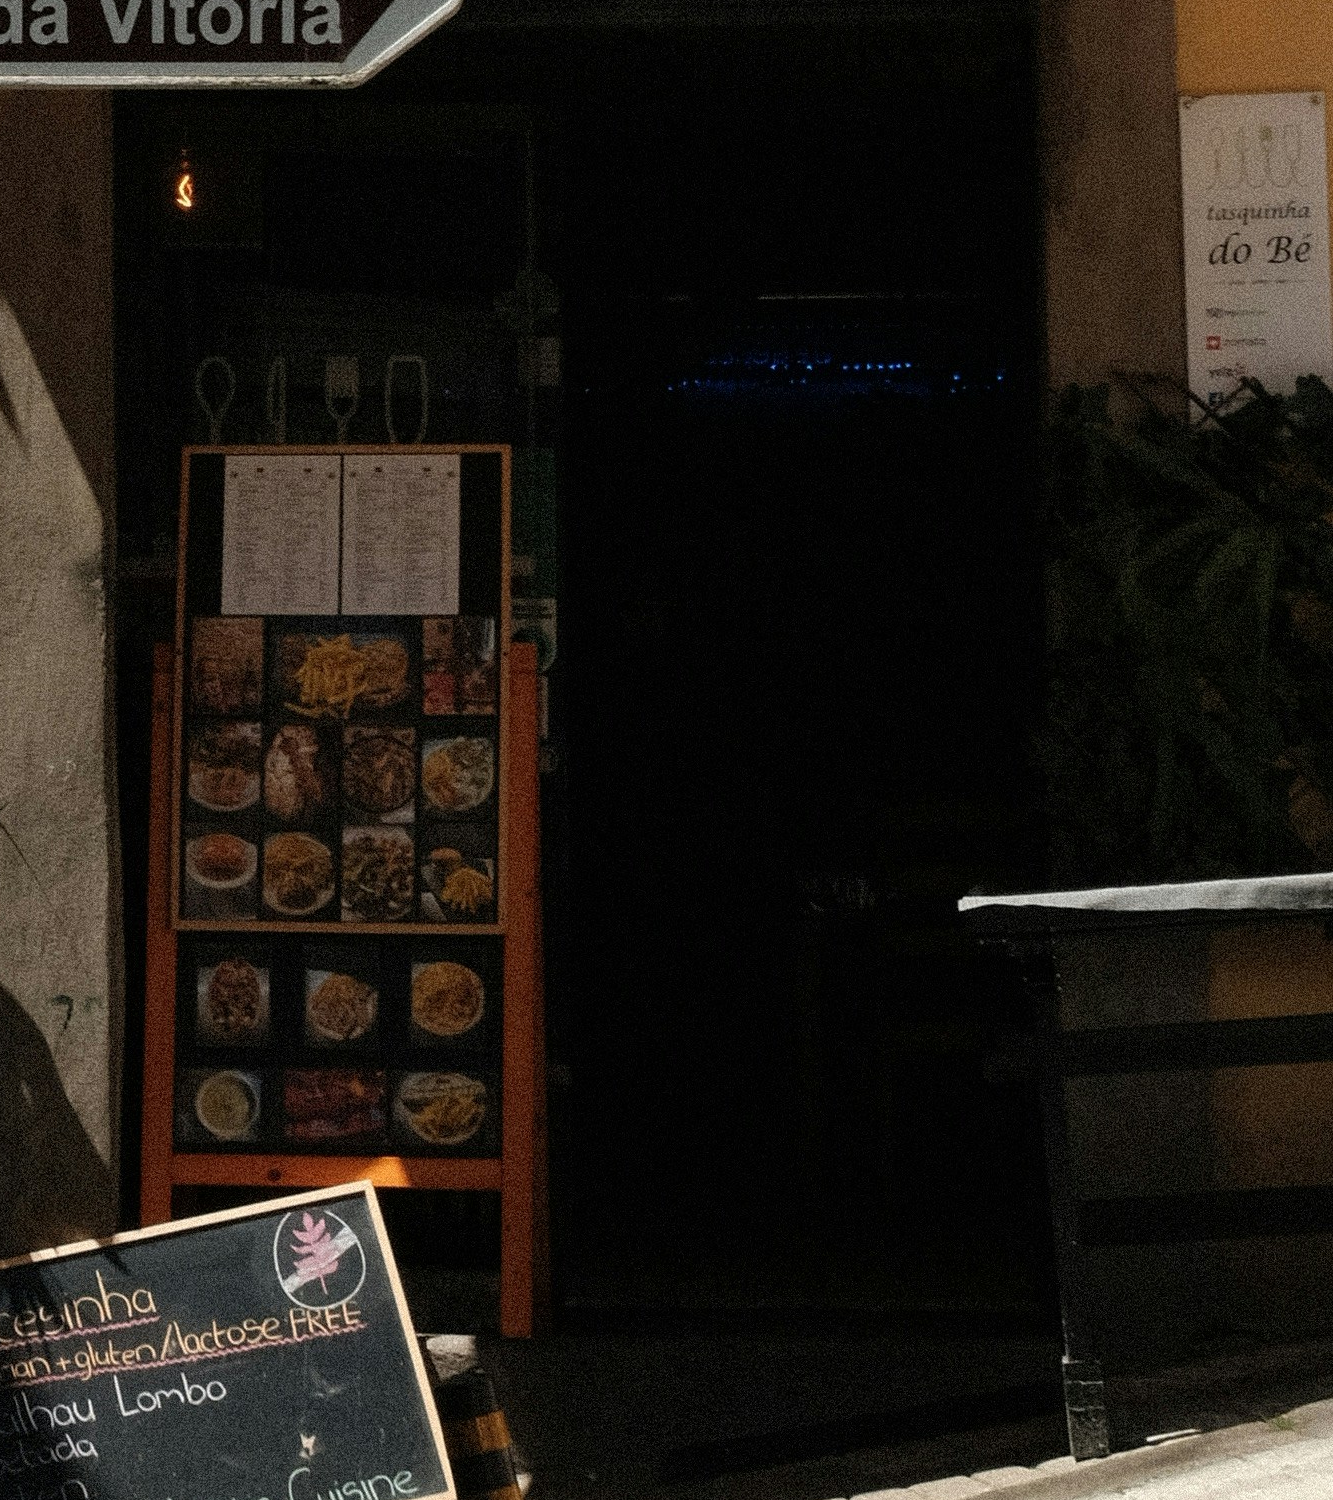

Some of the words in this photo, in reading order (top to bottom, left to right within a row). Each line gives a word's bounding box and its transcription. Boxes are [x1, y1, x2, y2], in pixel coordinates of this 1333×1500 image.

[1207, 201, 1310, 225] tasquinha
[1208, 232, 1251, 265] do
[1267, 234, 1312, 264] Bé
[289, 1301, 361, 1338] FREE
[113, 1372, 227, 1417] Lombo
